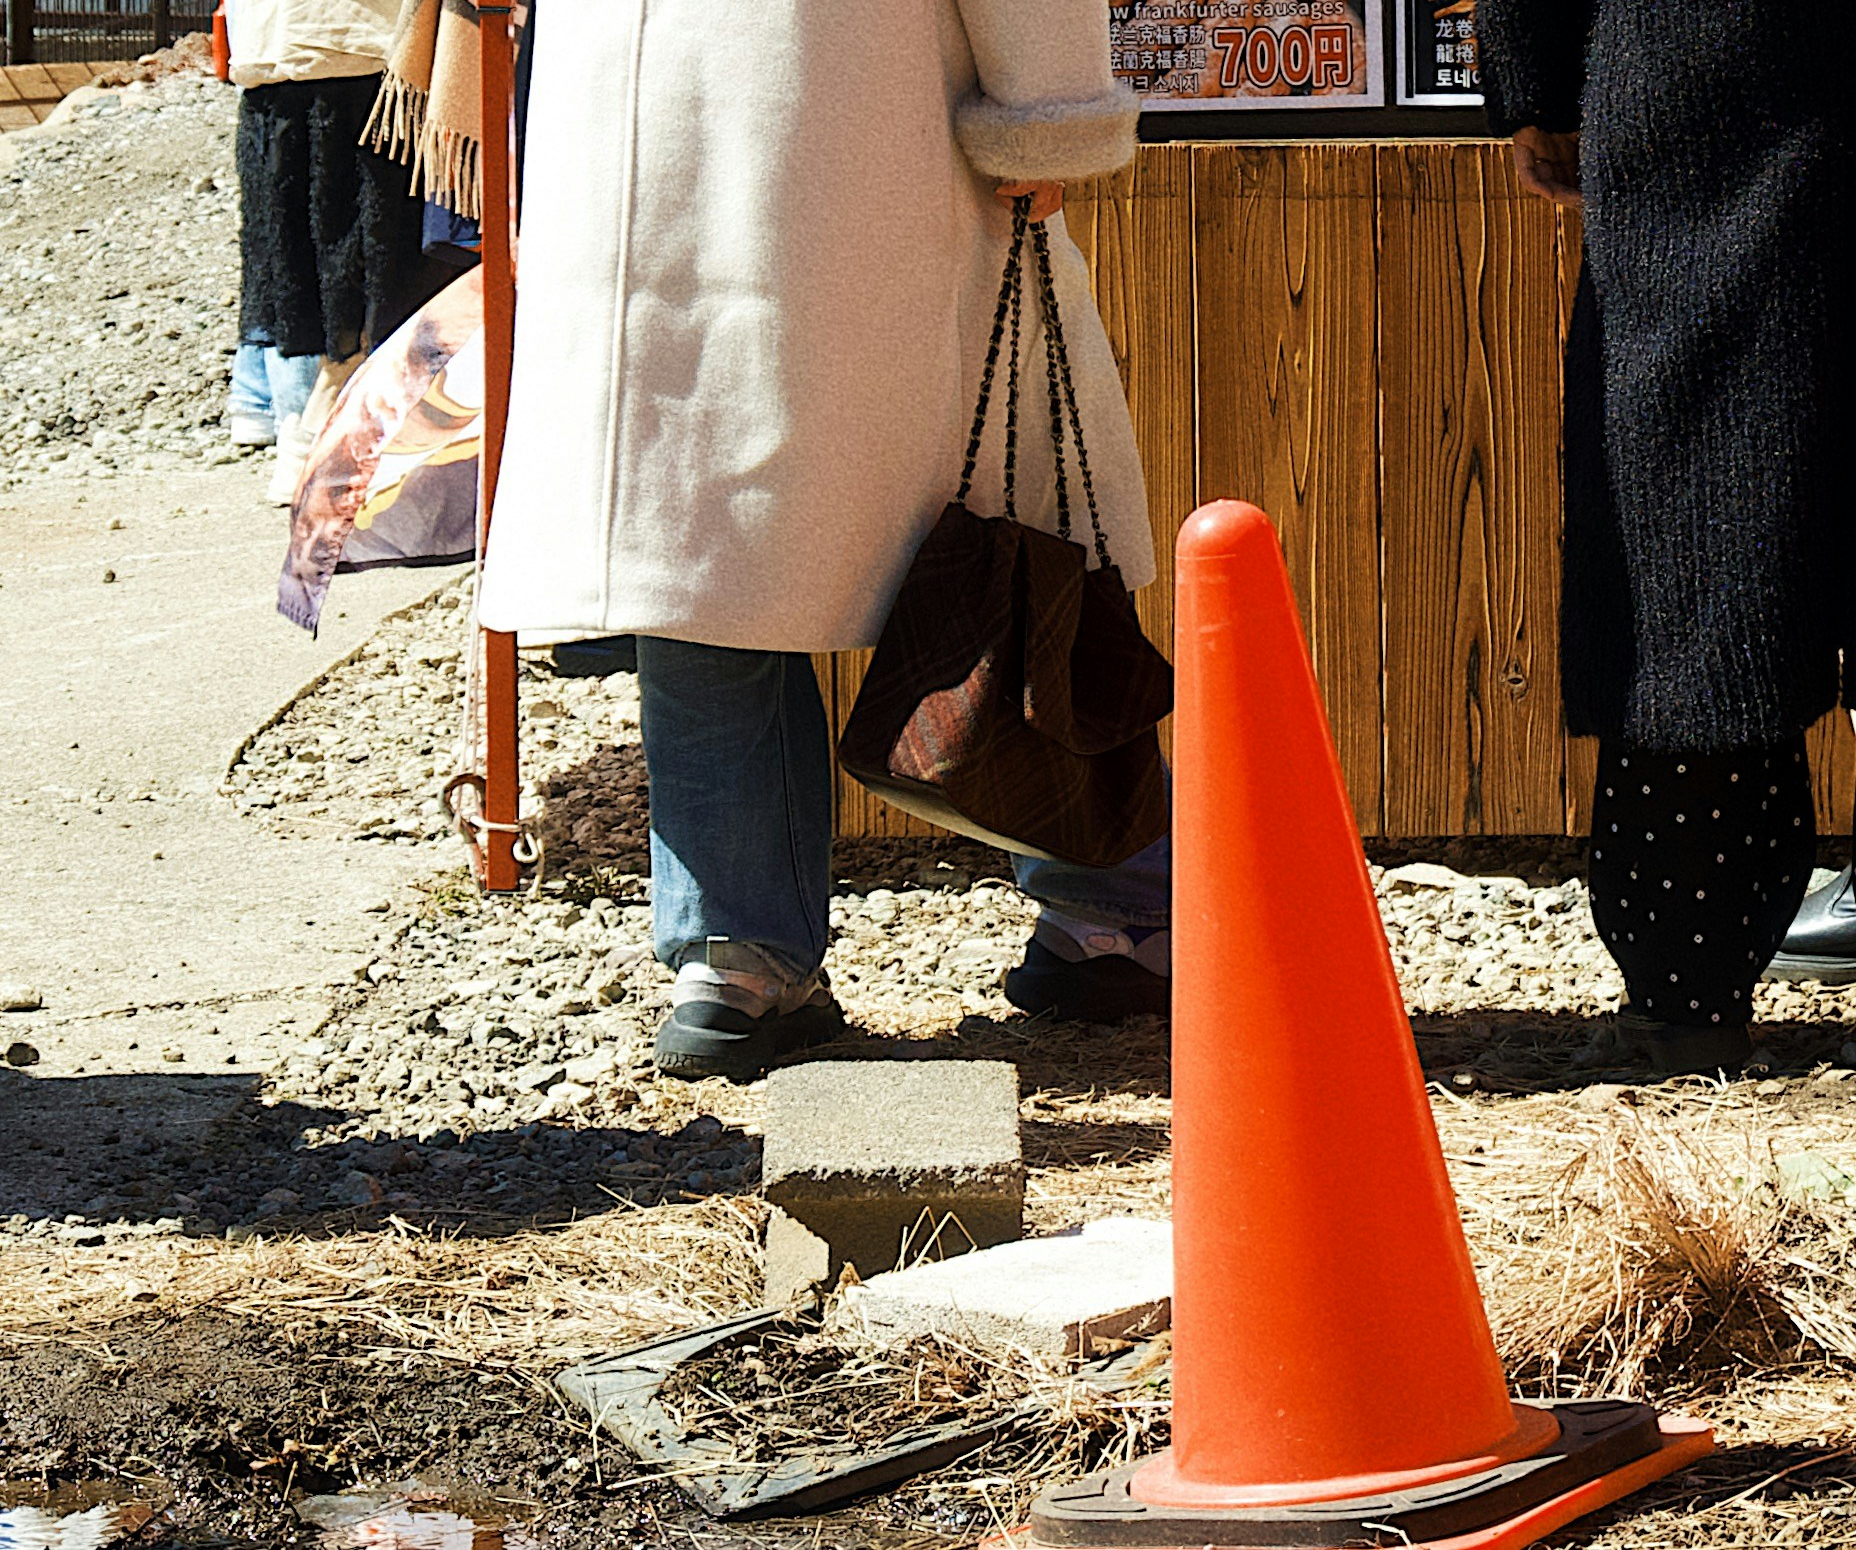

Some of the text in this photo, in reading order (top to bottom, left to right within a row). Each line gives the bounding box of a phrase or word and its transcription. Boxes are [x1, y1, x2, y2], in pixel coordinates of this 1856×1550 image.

[1135, 2, 1247, 20] frankfurter
[1253, 1, 1344, 20] sausages
[1214, 24, 1352, 88] 700円
[1153, 73, 1199, 94] 소시지
